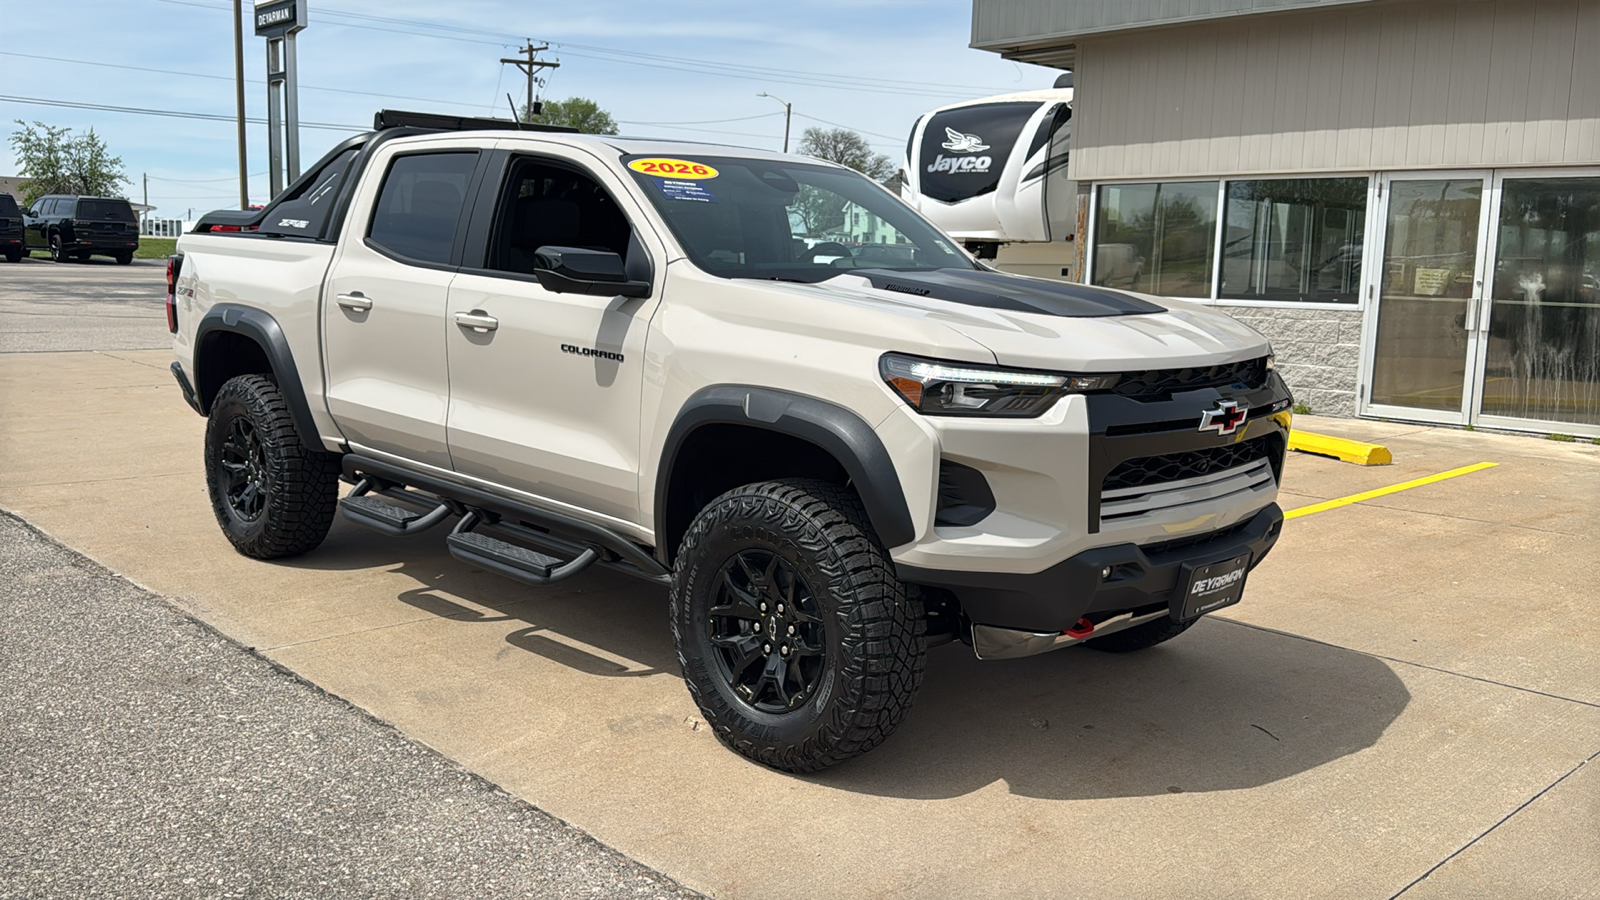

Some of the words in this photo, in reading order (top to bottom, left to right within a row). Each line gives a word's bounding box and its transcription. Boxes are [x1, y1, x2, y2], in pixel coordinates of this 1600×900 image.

[258, 7, 290, 26] DEYARMAN
[641, 162, 709, 175] 2026
[927, 153, 992, 174] Jayco
[278, 218, 309, 229] ZR2
[561, 343, 625, 363] COLORADO
[730, 525, 832, 614] GOODYEAR
[1190, 567, 1246, 595] DEYARMAN
[684, 564, 700, 626] TERRITORY
[692, 656, 782, 742] WRANGLER
